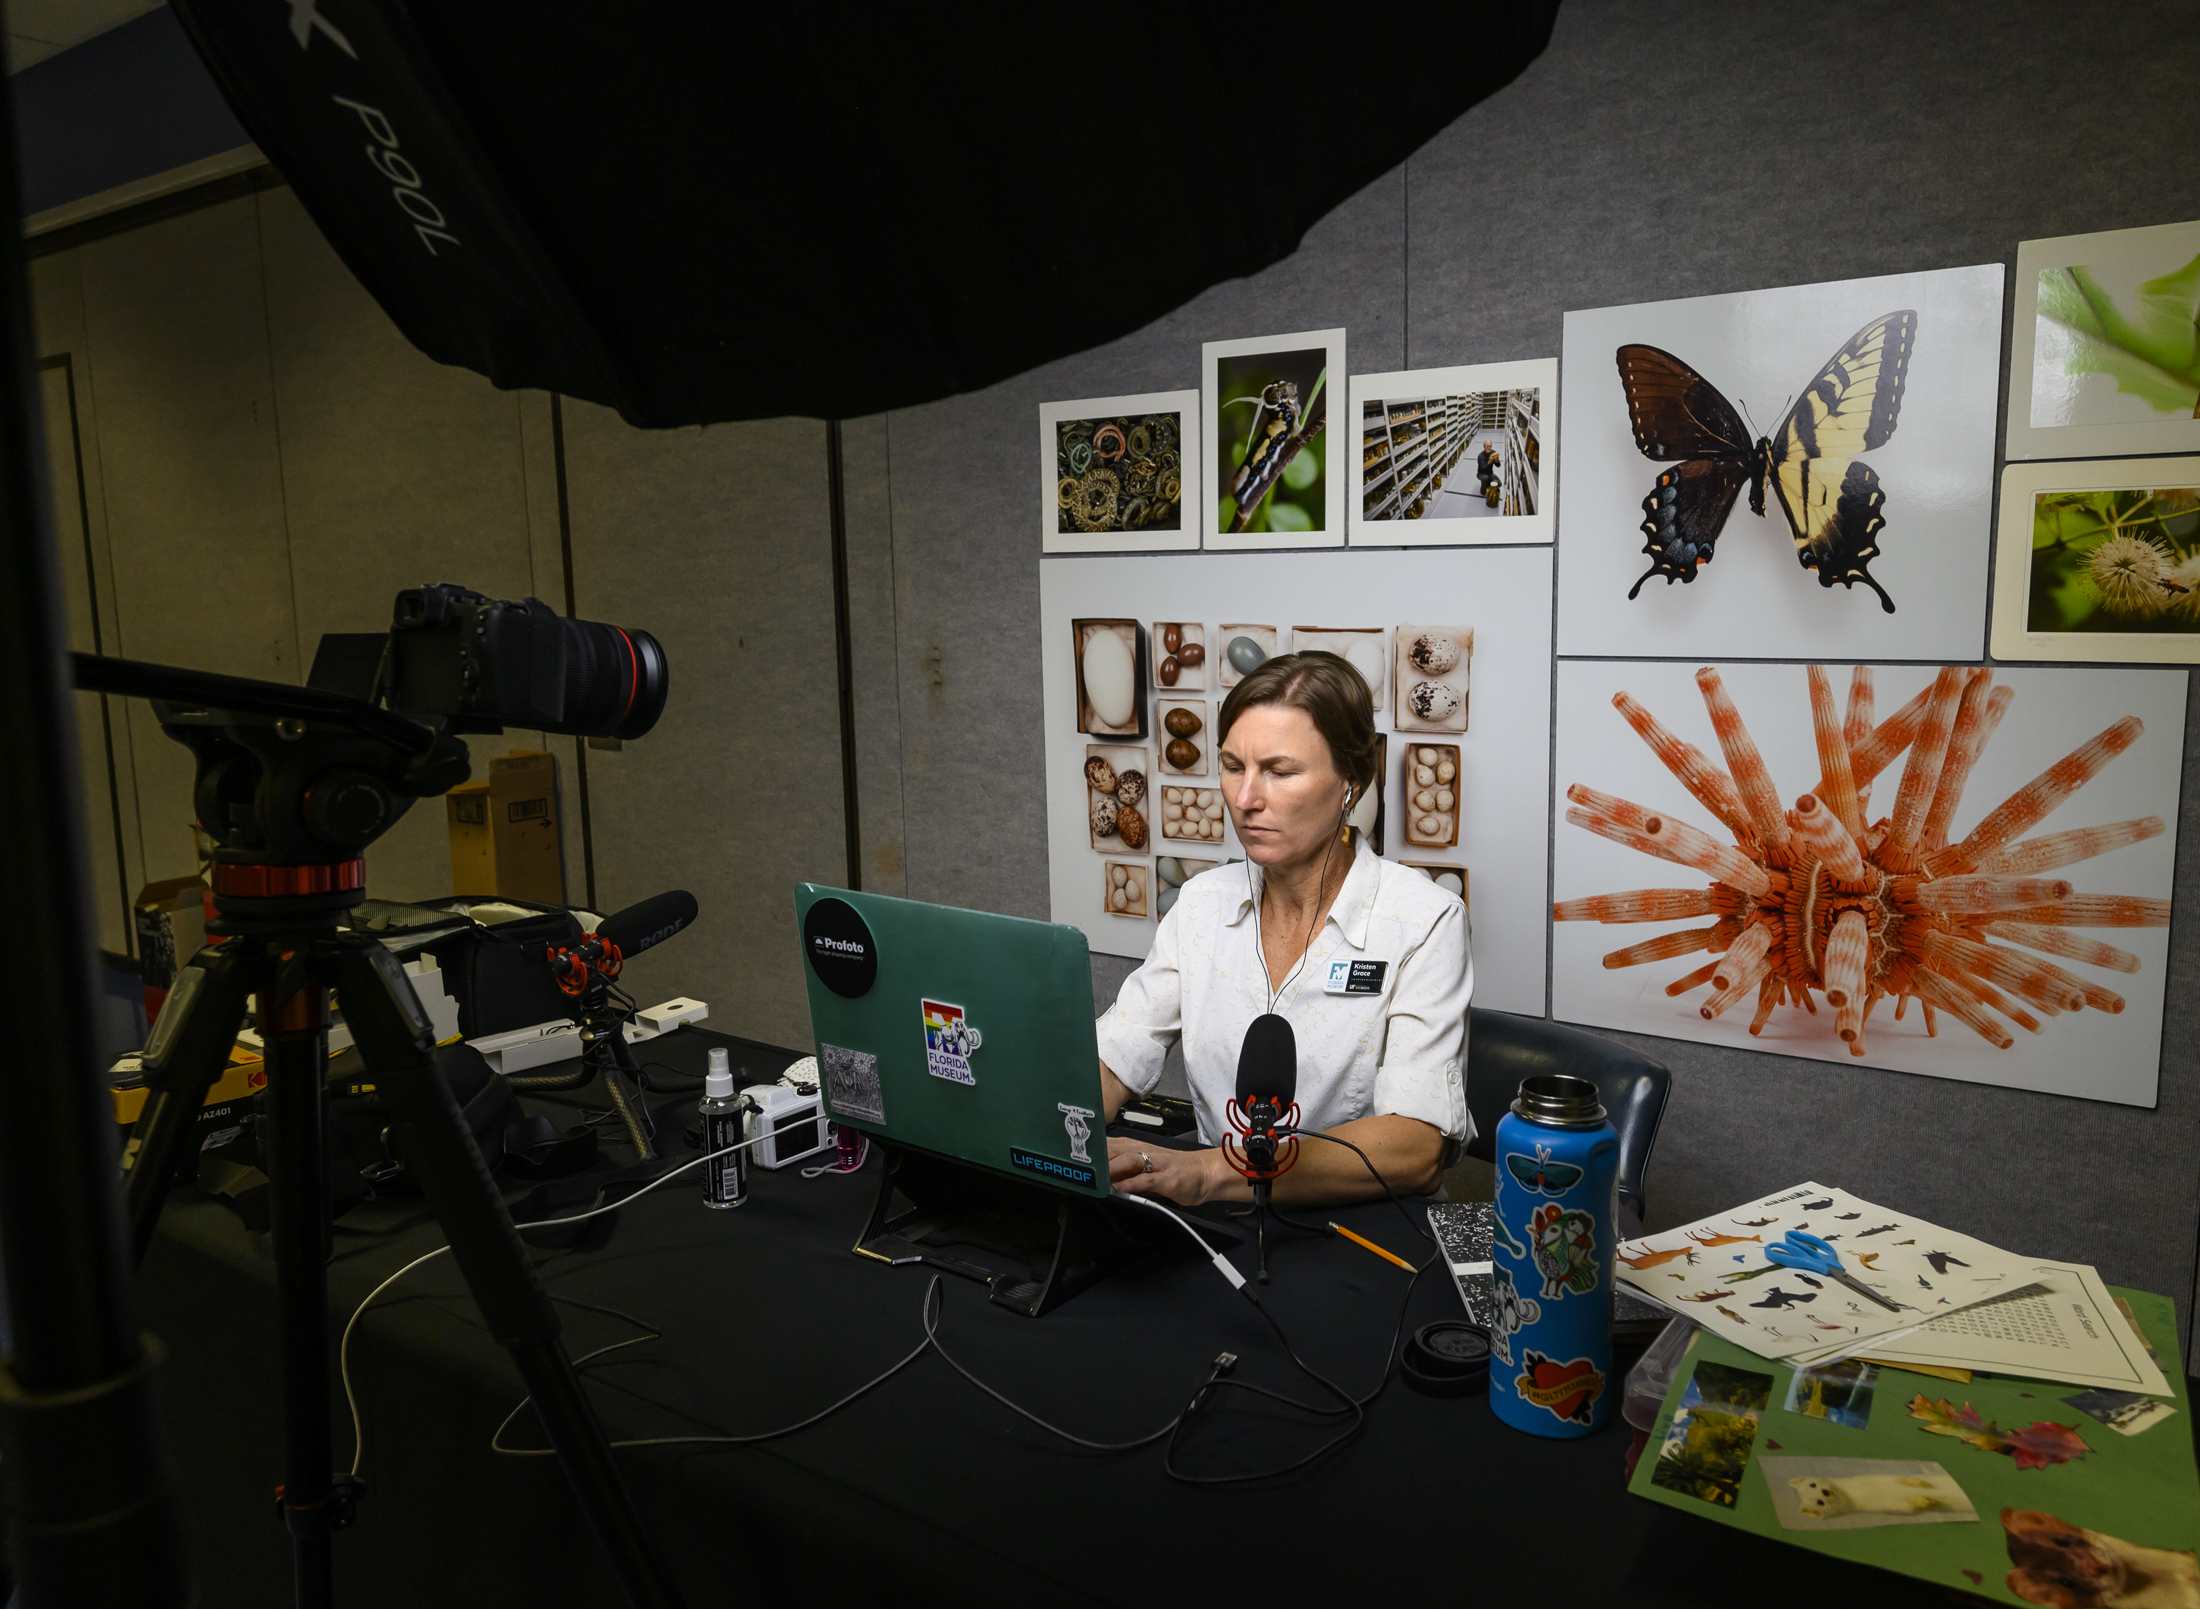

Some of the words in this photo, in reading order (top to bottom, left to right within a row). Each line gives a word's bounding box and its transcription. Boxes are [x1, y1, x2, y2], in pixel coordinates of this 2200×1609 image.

[333, 94, 461, 257] P90L
[639, 917, 684, 951] RØDE
[824, 937, 864, 953] Profoto
[928, 1051, 969, 1072] FLORIDA
[203, 1106, 231, 1120] AZ401
[1013, 1153, 1092, 1182] LIFEPROOF
[2071, 1303, 2089, 1319] Word
[2079, 1319, 2100, 1339] Search
